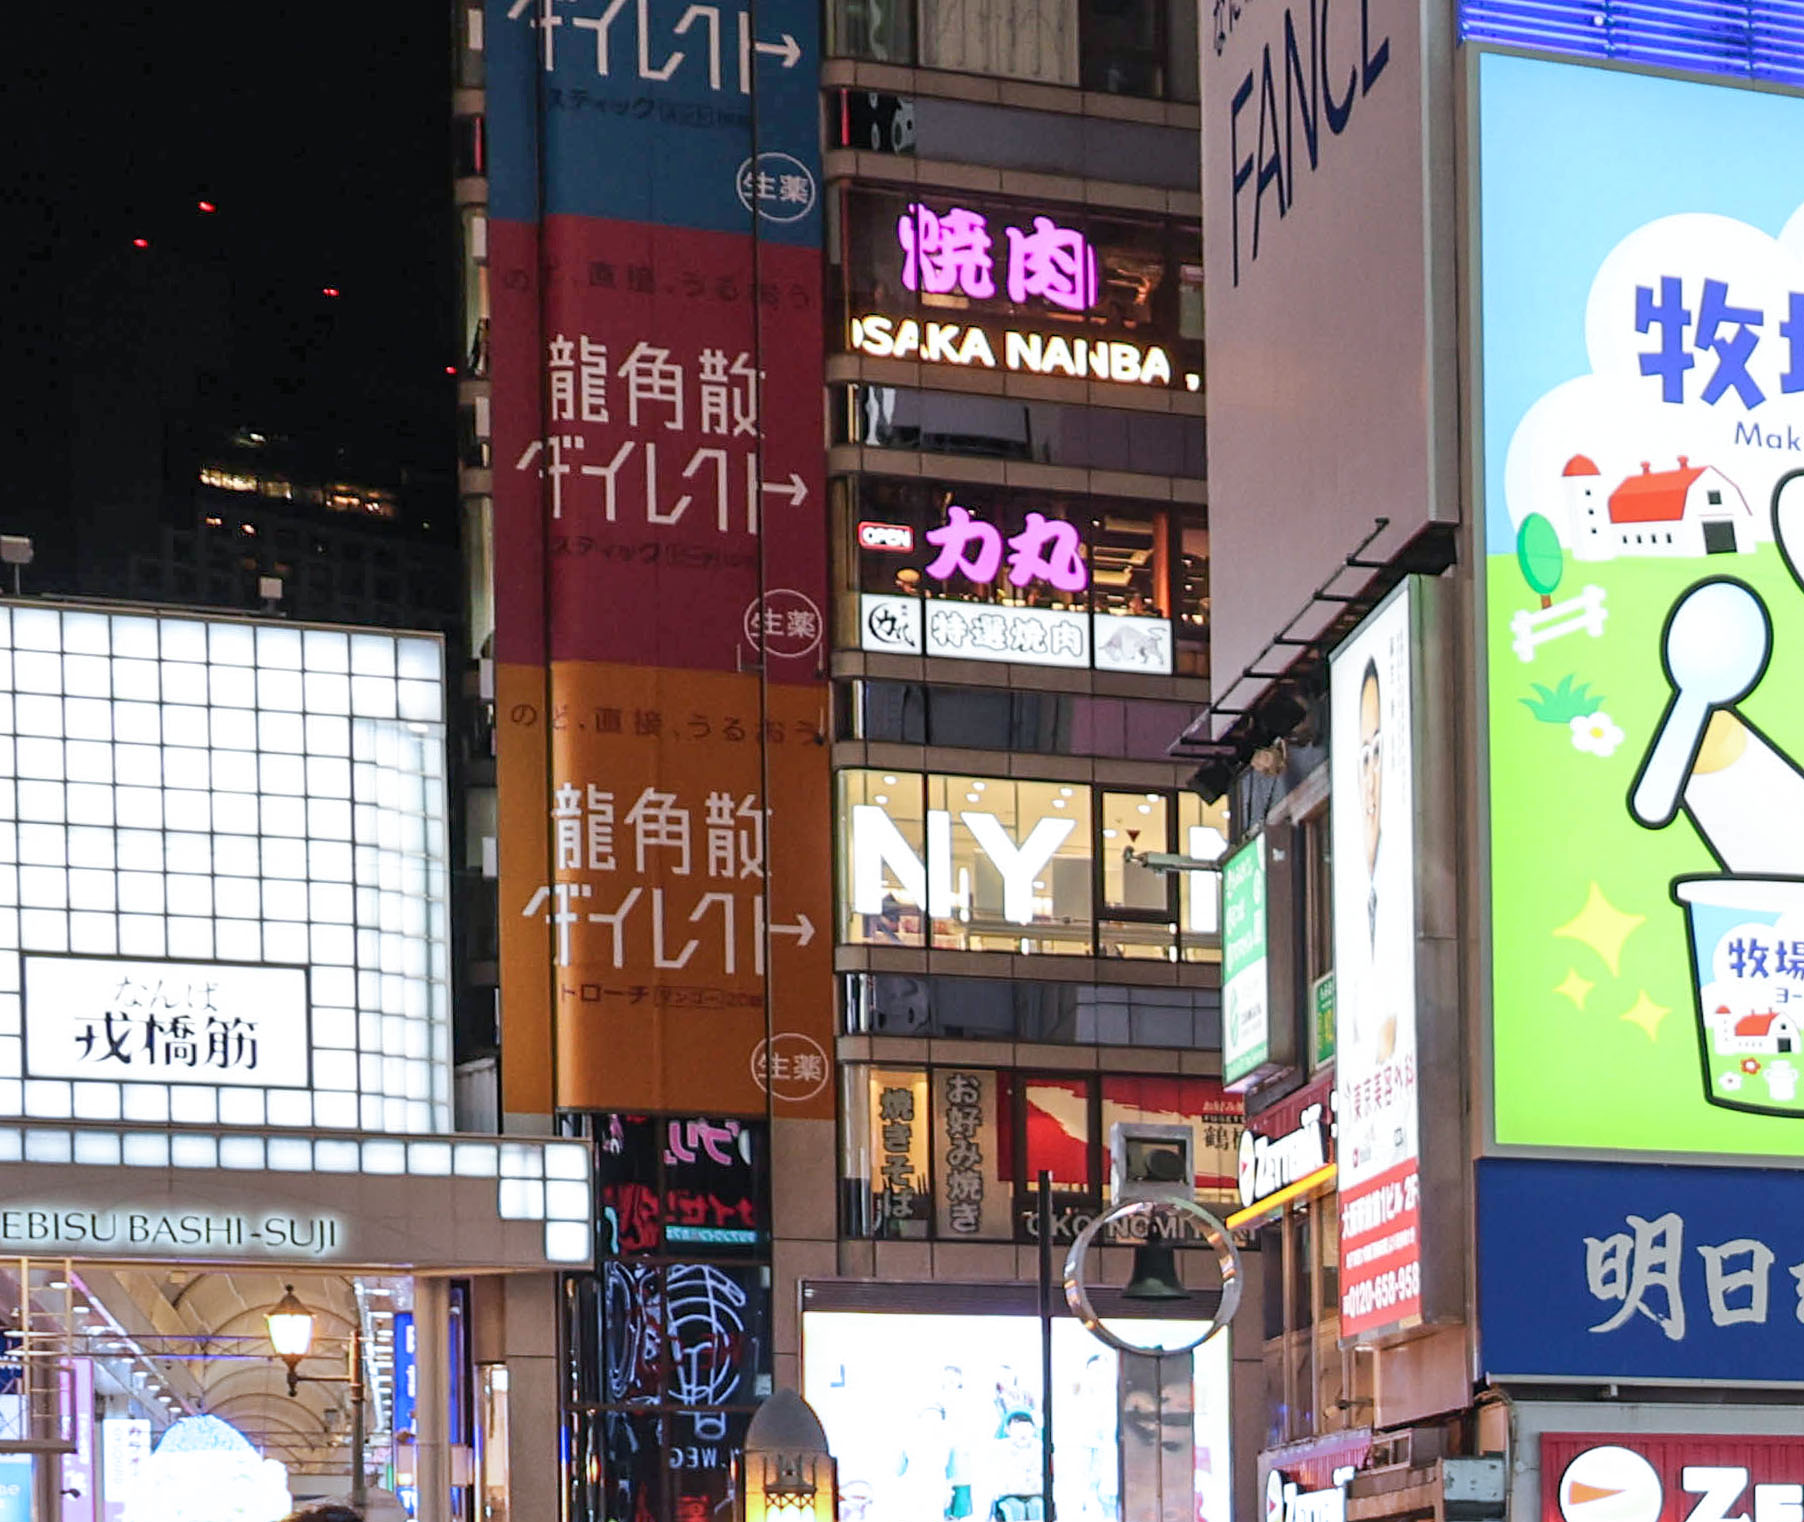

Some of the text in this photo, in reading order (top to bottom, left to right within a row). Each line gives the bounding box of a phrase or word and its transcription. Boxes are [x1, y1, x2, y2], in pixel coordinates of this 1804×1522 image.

[898, 202, 1099, 311] 焼肉
[547, 334, 766, 438] 龍角散
[1004, 328, 1171, 386] NANBA
[516, 435, 808, 534] ダイレクト
[925, 505, 1091, 593] 力丸
[930, 609, 1085, 658] 特選焼肉
[551, 782, 772, 880] 龍角散
[522, 882, 815, 976] ダイレクト
[114, 976, 220, 1012] なんば
[74, 1010, 260, 1070] 戎橋筋
[945, 1072, 984, 1234] お好み焼き
[1, 1211, 118, 1242] EBISU
